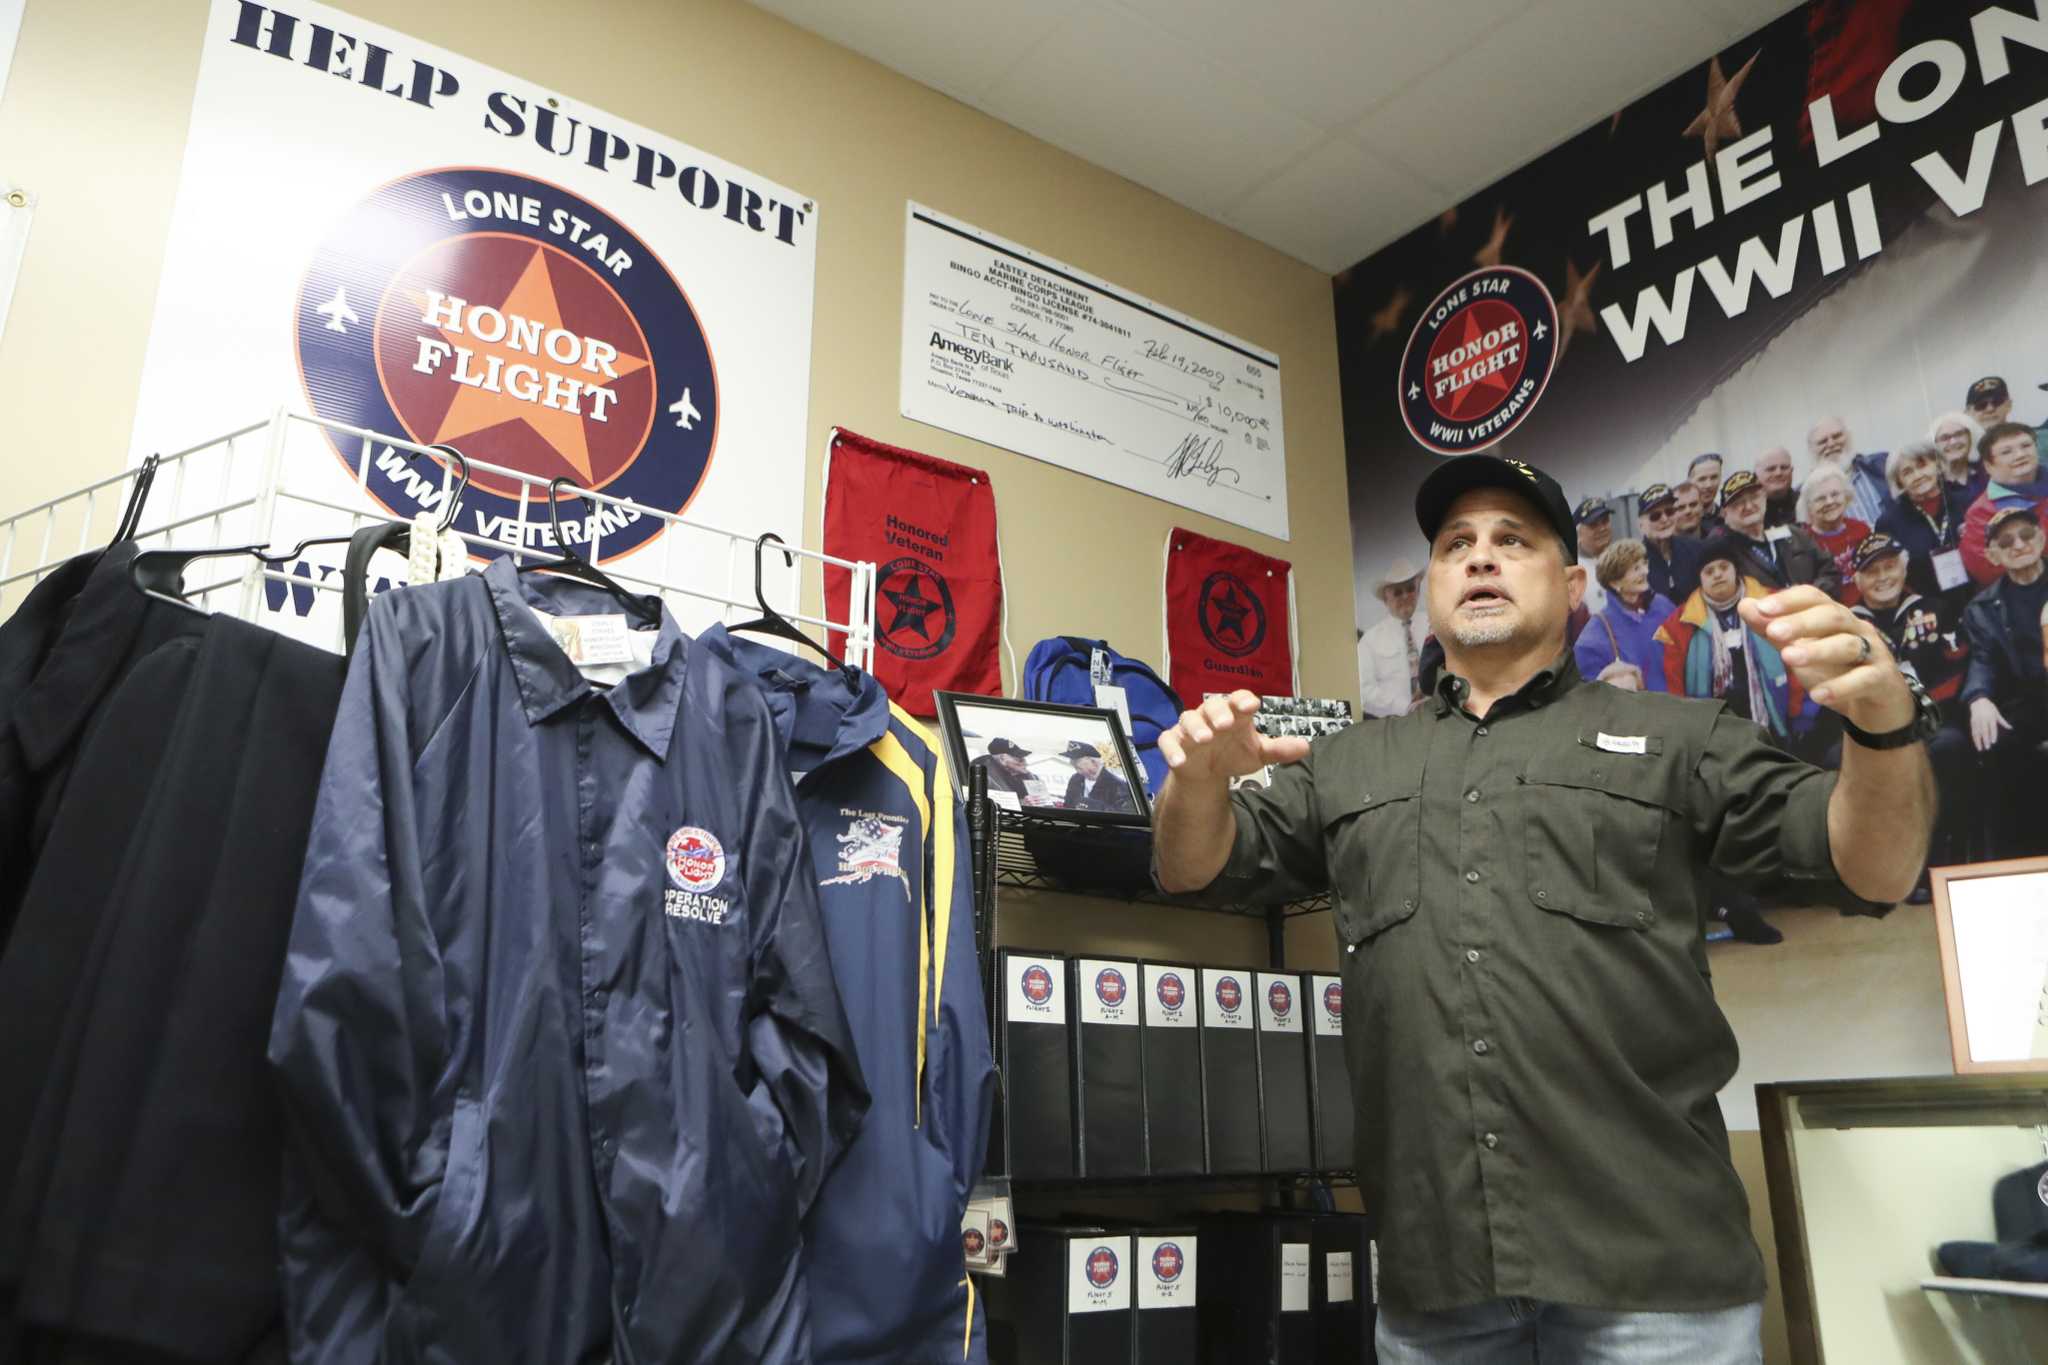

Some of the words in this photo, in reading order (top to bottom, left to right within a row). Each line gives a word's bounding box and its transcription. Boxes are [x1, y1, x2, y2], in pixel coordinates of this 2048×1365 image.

[230, 0, 460, 109] HELP
[484, 91, 806, 247] SUPPORT
[1587, 124, 1782, 271] THE
[441, 189, 542, 227] LONE
[548, 208, 634, 277] STAR
[949, 260, 981, 279] BINGO
[1042, 297, 1080, 318] LICENSE
[988, 266, 1025, 288] MARINE
[1027, 281, 1058, 300] CORPS
[1060, 295, 1094, 315] LEAGUE
[993, 259, 1028, 279] EASTEX
[1030, 273, 1090, 304] DETACHMENT
[1599, 182, 1883, 364] WWII
[1428, 287, 1469, 330] LONE
[1472, 278, 1511, 297] STAR
[421, 289, 620, 379] HONOR
[955, 321, 996, 349] TEN
[1005, 340, 1089, 381] THOUSAND
[1431, 320, 1520, 378] HONOR
[412, 335, 619, 423] FLIGHT
[1434, 343, 1521, 400] FLIGHT
[1429, 421, 1464, 443] WWII
[1467, 378, 1536, 441] VETERANS
[474, 496, 642, 548] VETERANS
[884, 531, 944, 561] Veteran
[886, 514, 949, 547] Honored
[1203, 657, 1264, 679] Guardian
[664, 903, 723, 925] RESOLVE
